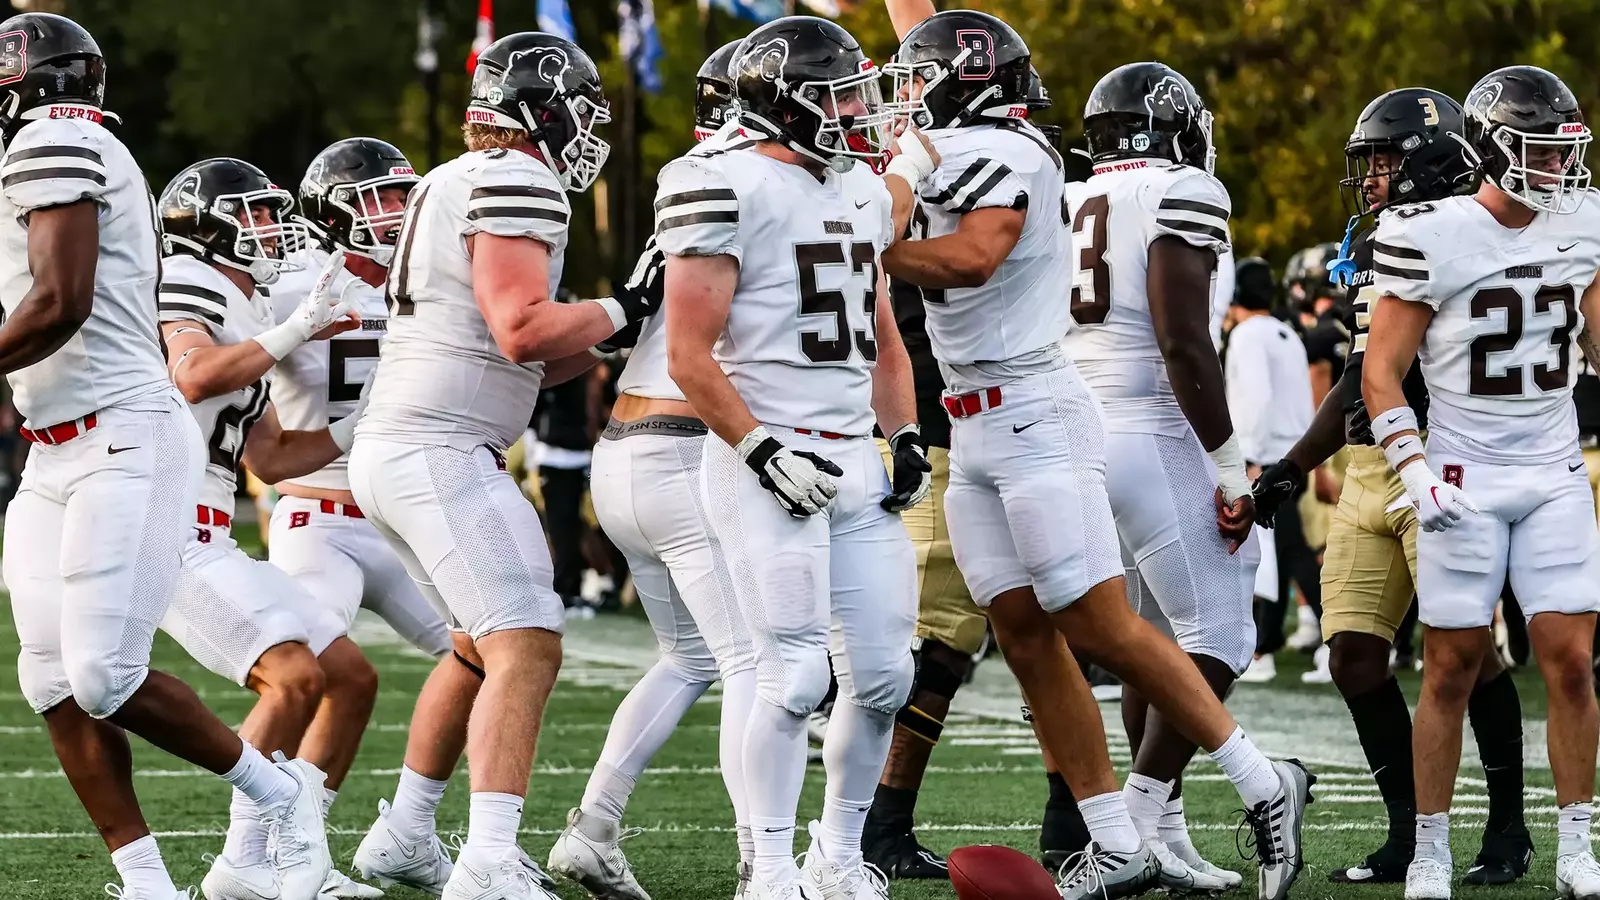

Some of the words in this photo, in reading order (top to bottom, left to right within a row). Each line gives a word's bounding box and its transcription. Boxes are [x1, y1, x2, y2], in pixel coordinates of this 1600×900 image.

[956, 29, 995, 81] B
[49, 106, 85, 119] EVER
[711, 107, 721, 120] JB
[1418, 98, 1440, 126] 3
[1562, 125, 1583, 133] BEARS
[1118, 138, 1129, 150] JB
[1134, 138, 1147, 148] BT
[823, 220, 854, 235] BROWN
[1352, 269, 1374, 286] BRY
[1505, 264, 1543, 279] BROWN
[793, 240, 879, 365] 53
[1468, 282, 1577, 398] 23
